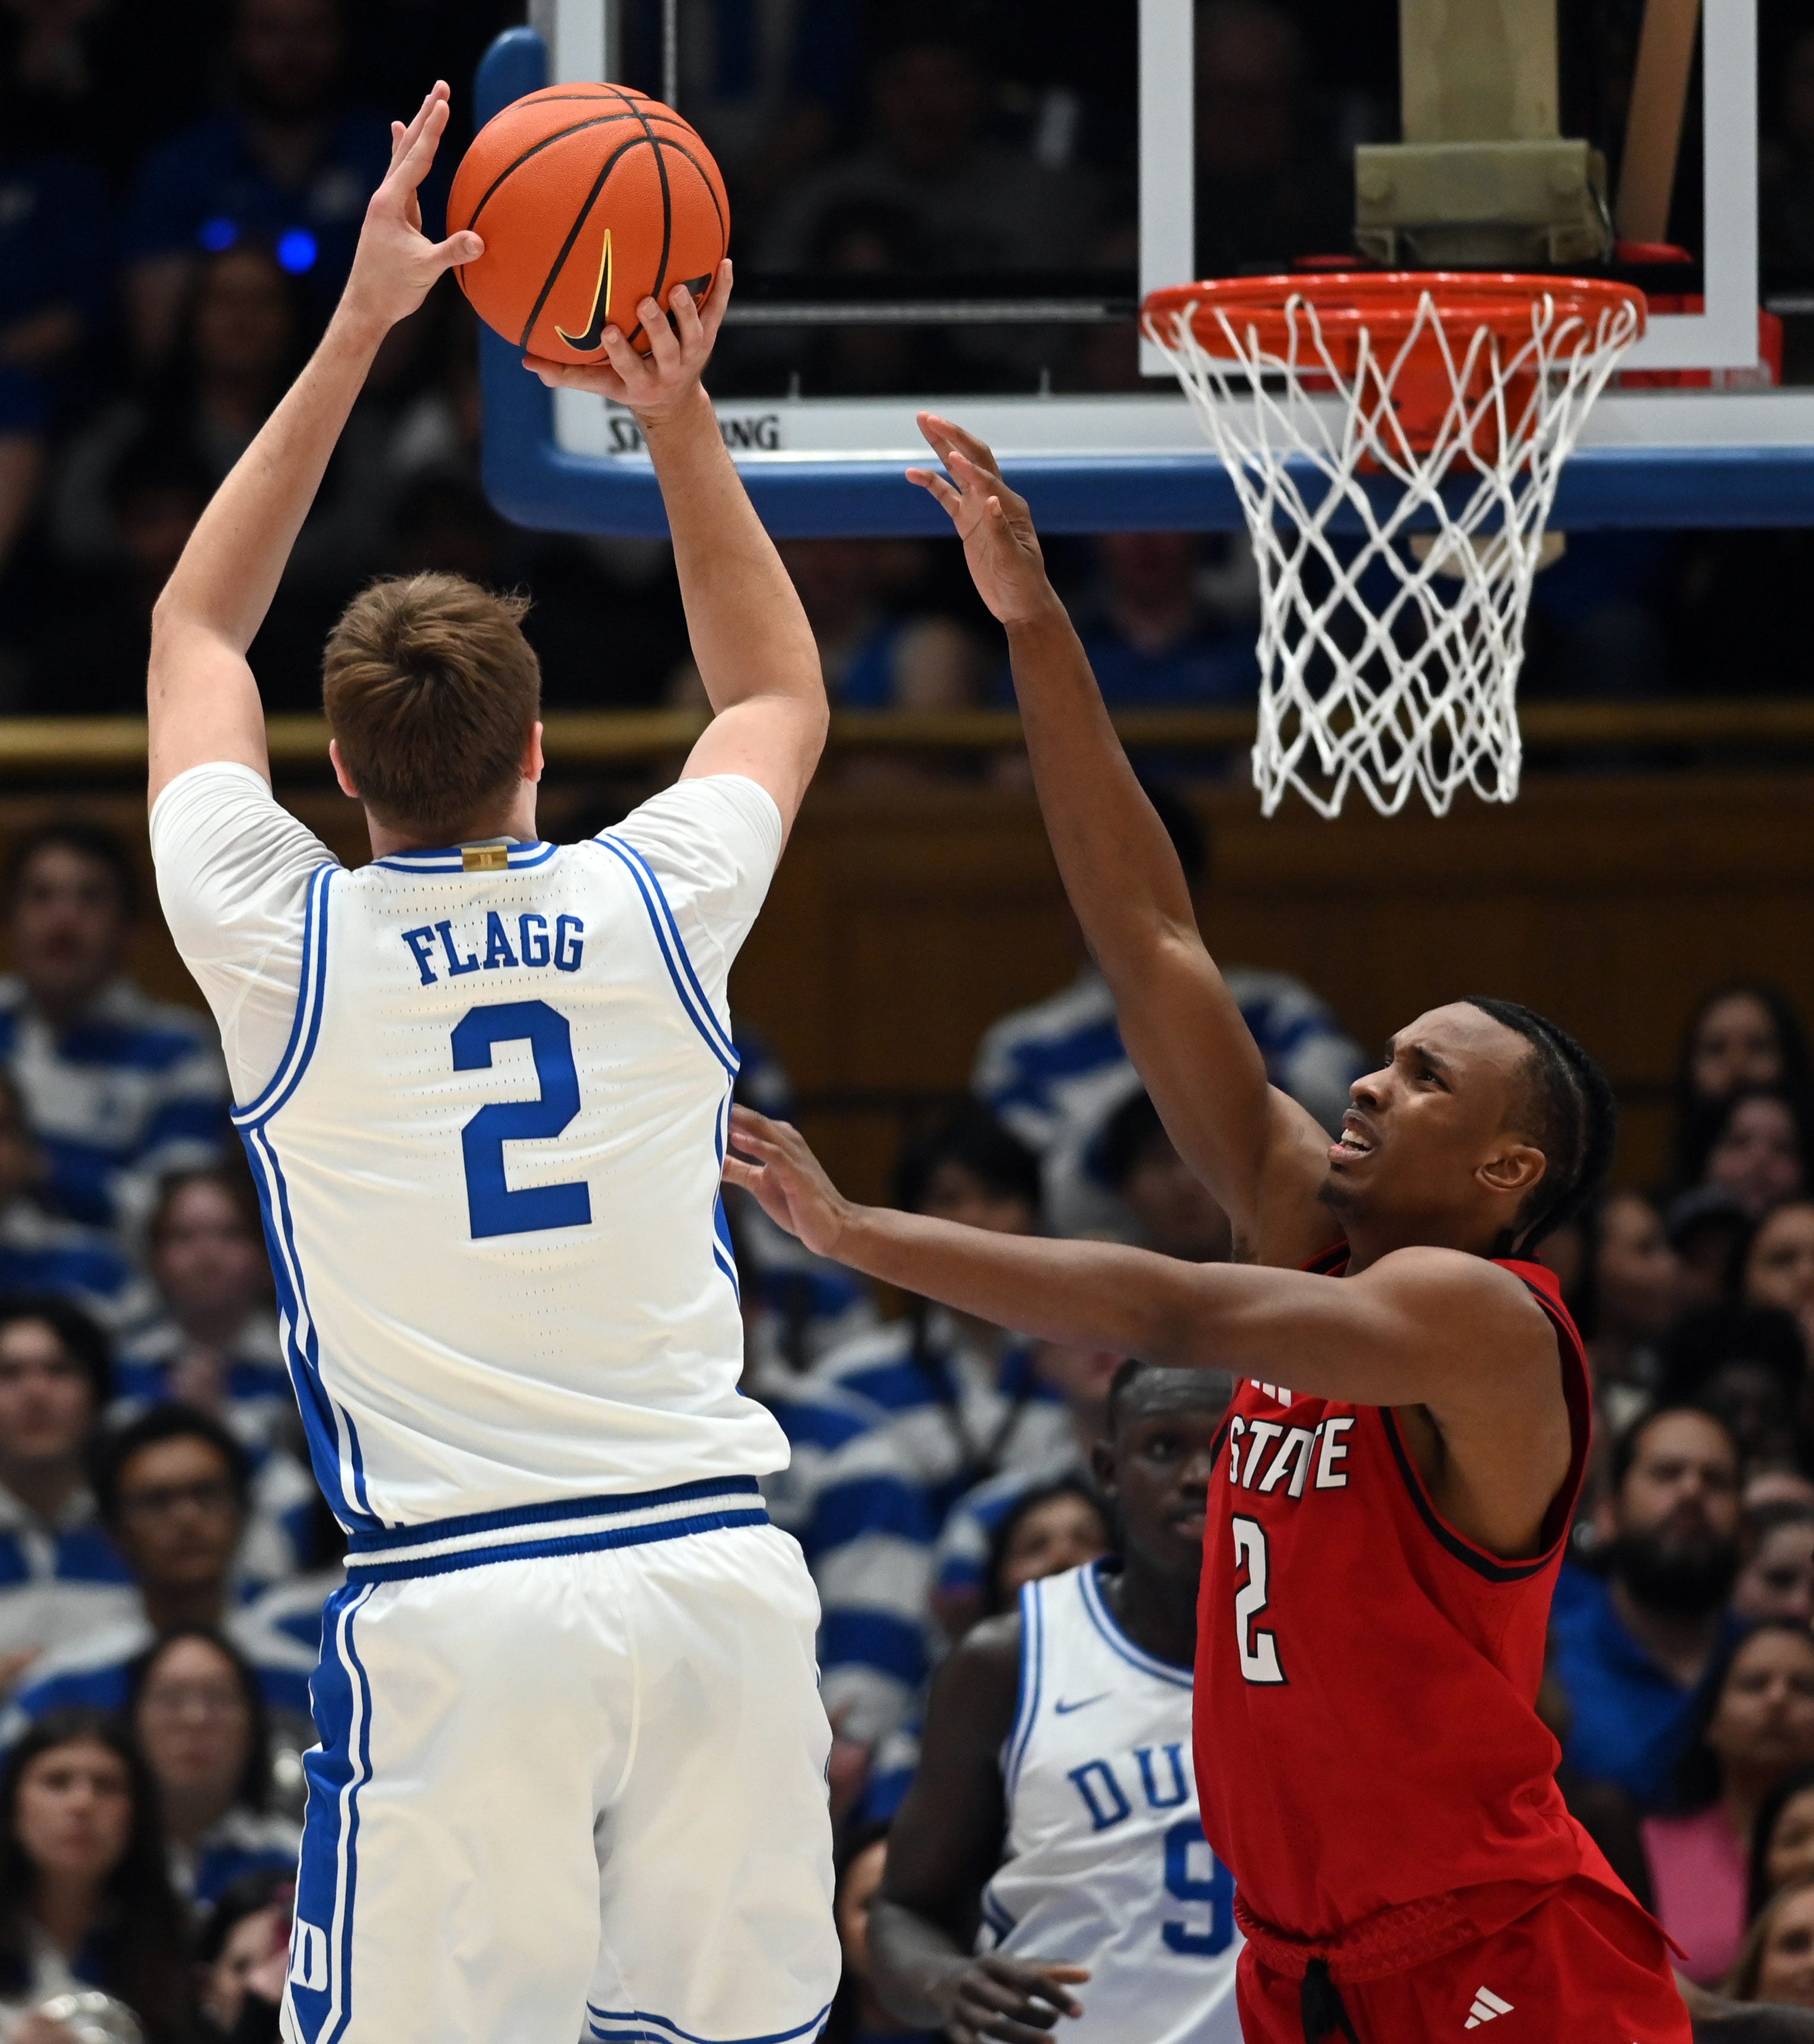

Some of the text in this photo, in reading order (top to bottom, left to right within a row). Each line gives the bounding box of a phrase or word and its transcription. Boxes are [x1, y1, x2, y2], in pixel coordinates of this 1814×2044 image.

[607, 414, 779, 455] SPING
[401, 911, 585, 986] FLAGG
[450, 999, 592, 1239] 2
[1232, 1512, 1289, 1685] 2
[1067, 1743, 1190, 1831] DU
[1162, 1818, 1235, 1956] 9
[290, 1916, 328, 1992] D
